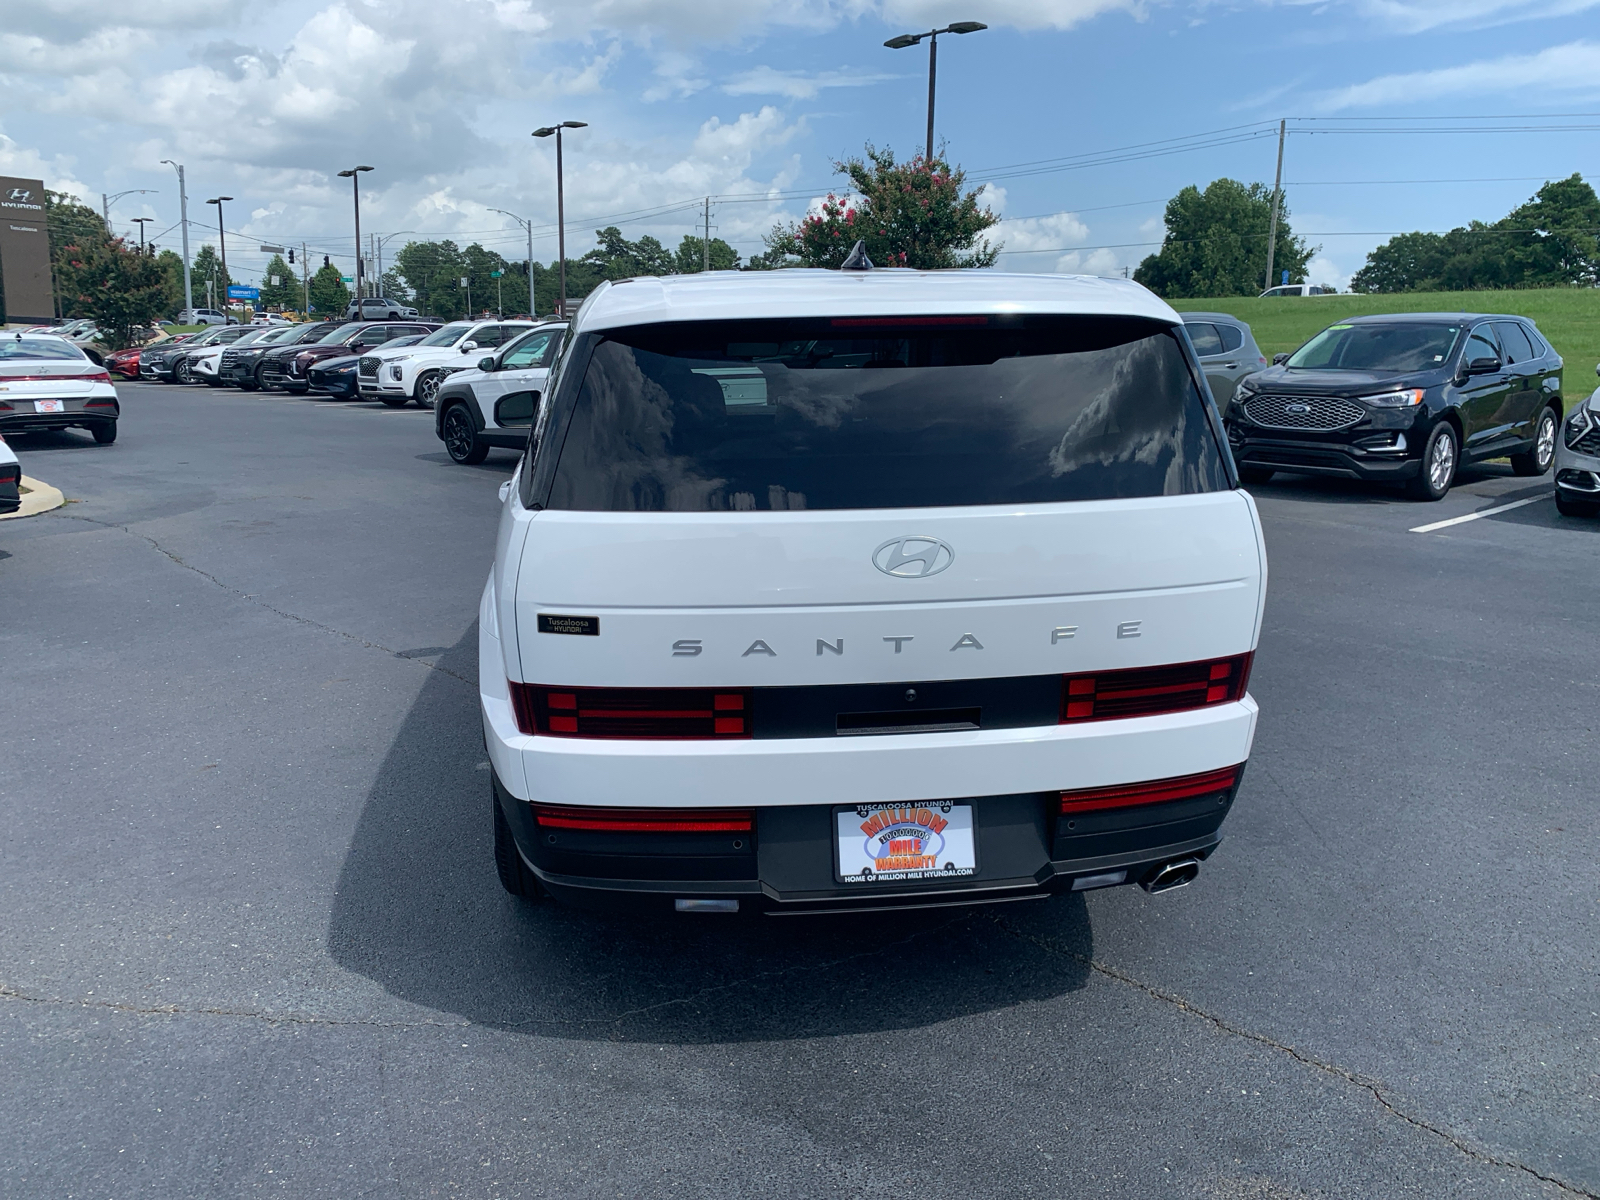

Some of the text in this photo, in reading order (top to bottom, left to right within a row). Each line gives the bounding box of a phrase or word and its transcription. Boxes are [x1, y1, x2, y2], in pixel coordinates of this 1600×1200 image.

[1, 202, 42, 210] HYUNDAI
[547, 617, 589, 627] Tuscaloosa
[671, 620, 1142, 658] SANTA FE
[857, 800, 954, 811] TUSCALOOSA HYUNDAI
[860, 807, 948, 838] MILLION
[889, 838, 922, 856] MILE
[875, 855, 938, 871] WARRANTY
[844, 868, 973, 883] HOME OF MILLION MILE HYUNDAI.COM
